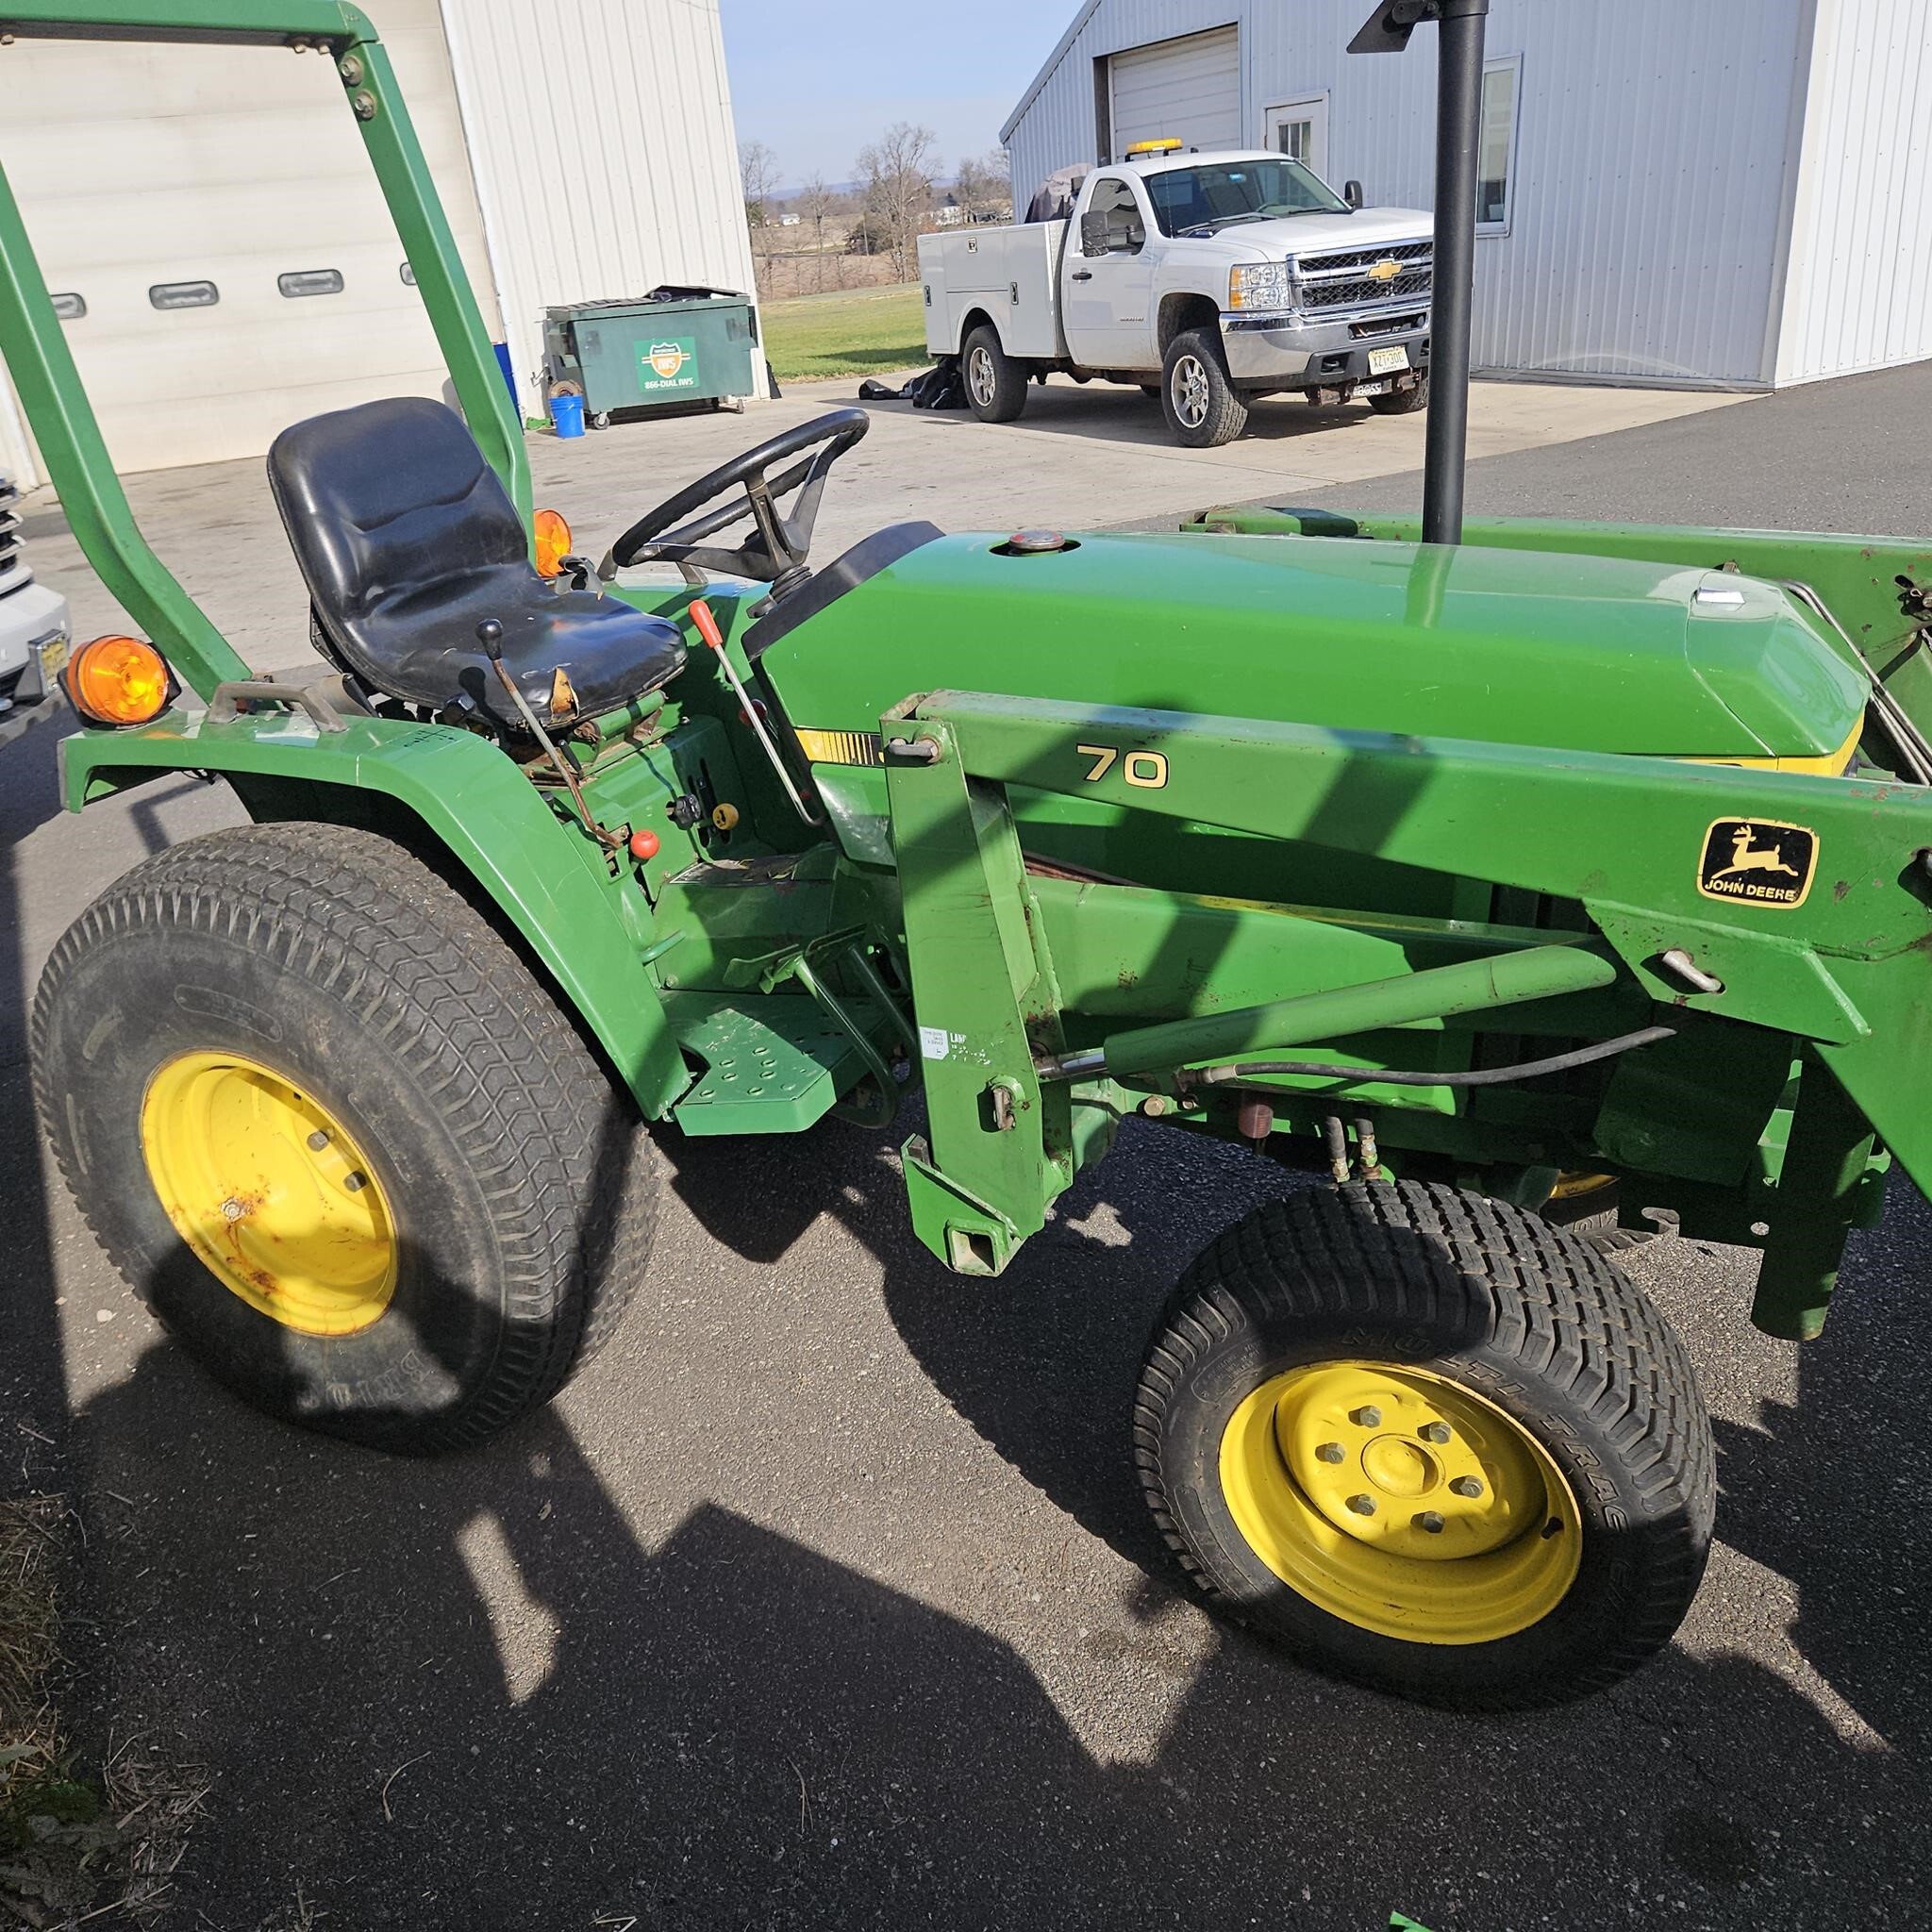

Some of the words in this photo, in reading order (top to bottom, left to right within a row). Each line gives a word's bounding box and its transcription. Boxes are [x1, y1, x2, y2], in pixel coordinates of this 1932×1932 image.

[678, 377, 694, 386] IWS
[1076, 742, 1170, 789] 70
[1704, 878, 1744, 894] JOHN
[1745, 884, 1797, 902] DEERE
